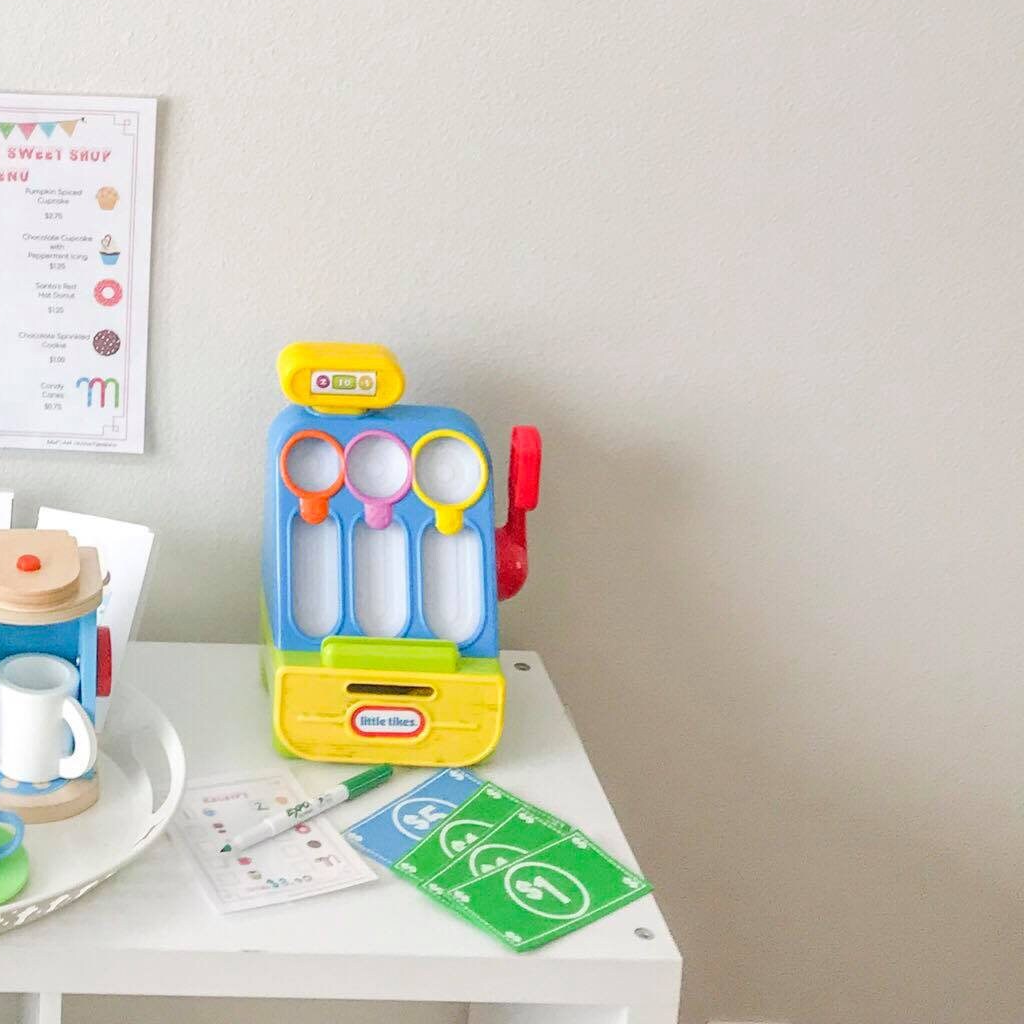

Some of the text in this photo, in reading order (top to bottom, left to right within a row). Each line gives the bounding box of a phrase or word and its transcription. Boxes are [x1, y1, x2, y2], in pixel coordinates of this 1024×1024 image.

[7, 145, 62, 161] SWEET
[70, 147, 112, 162] SHOP
[24, 187, 83, 197] Pumpkin Spiced
[37, 197, 70, 206] Cupcake
[22, 233, 93, 243] Chocolate Cupcake
[49, 242, 65, 250] with
[27, 251, 69, 261] Peppermint
[62, 282, 77, 290] Red
[53, 291, 76, 299] Donut
[18, 331, 55, 340] Chocolate
[41, 341, 67, 349] Cookie
[40, 381, 65, 391] Candy
[41, 391, 64, 399] Canes
[360, 716, 416, 727] little tikes
